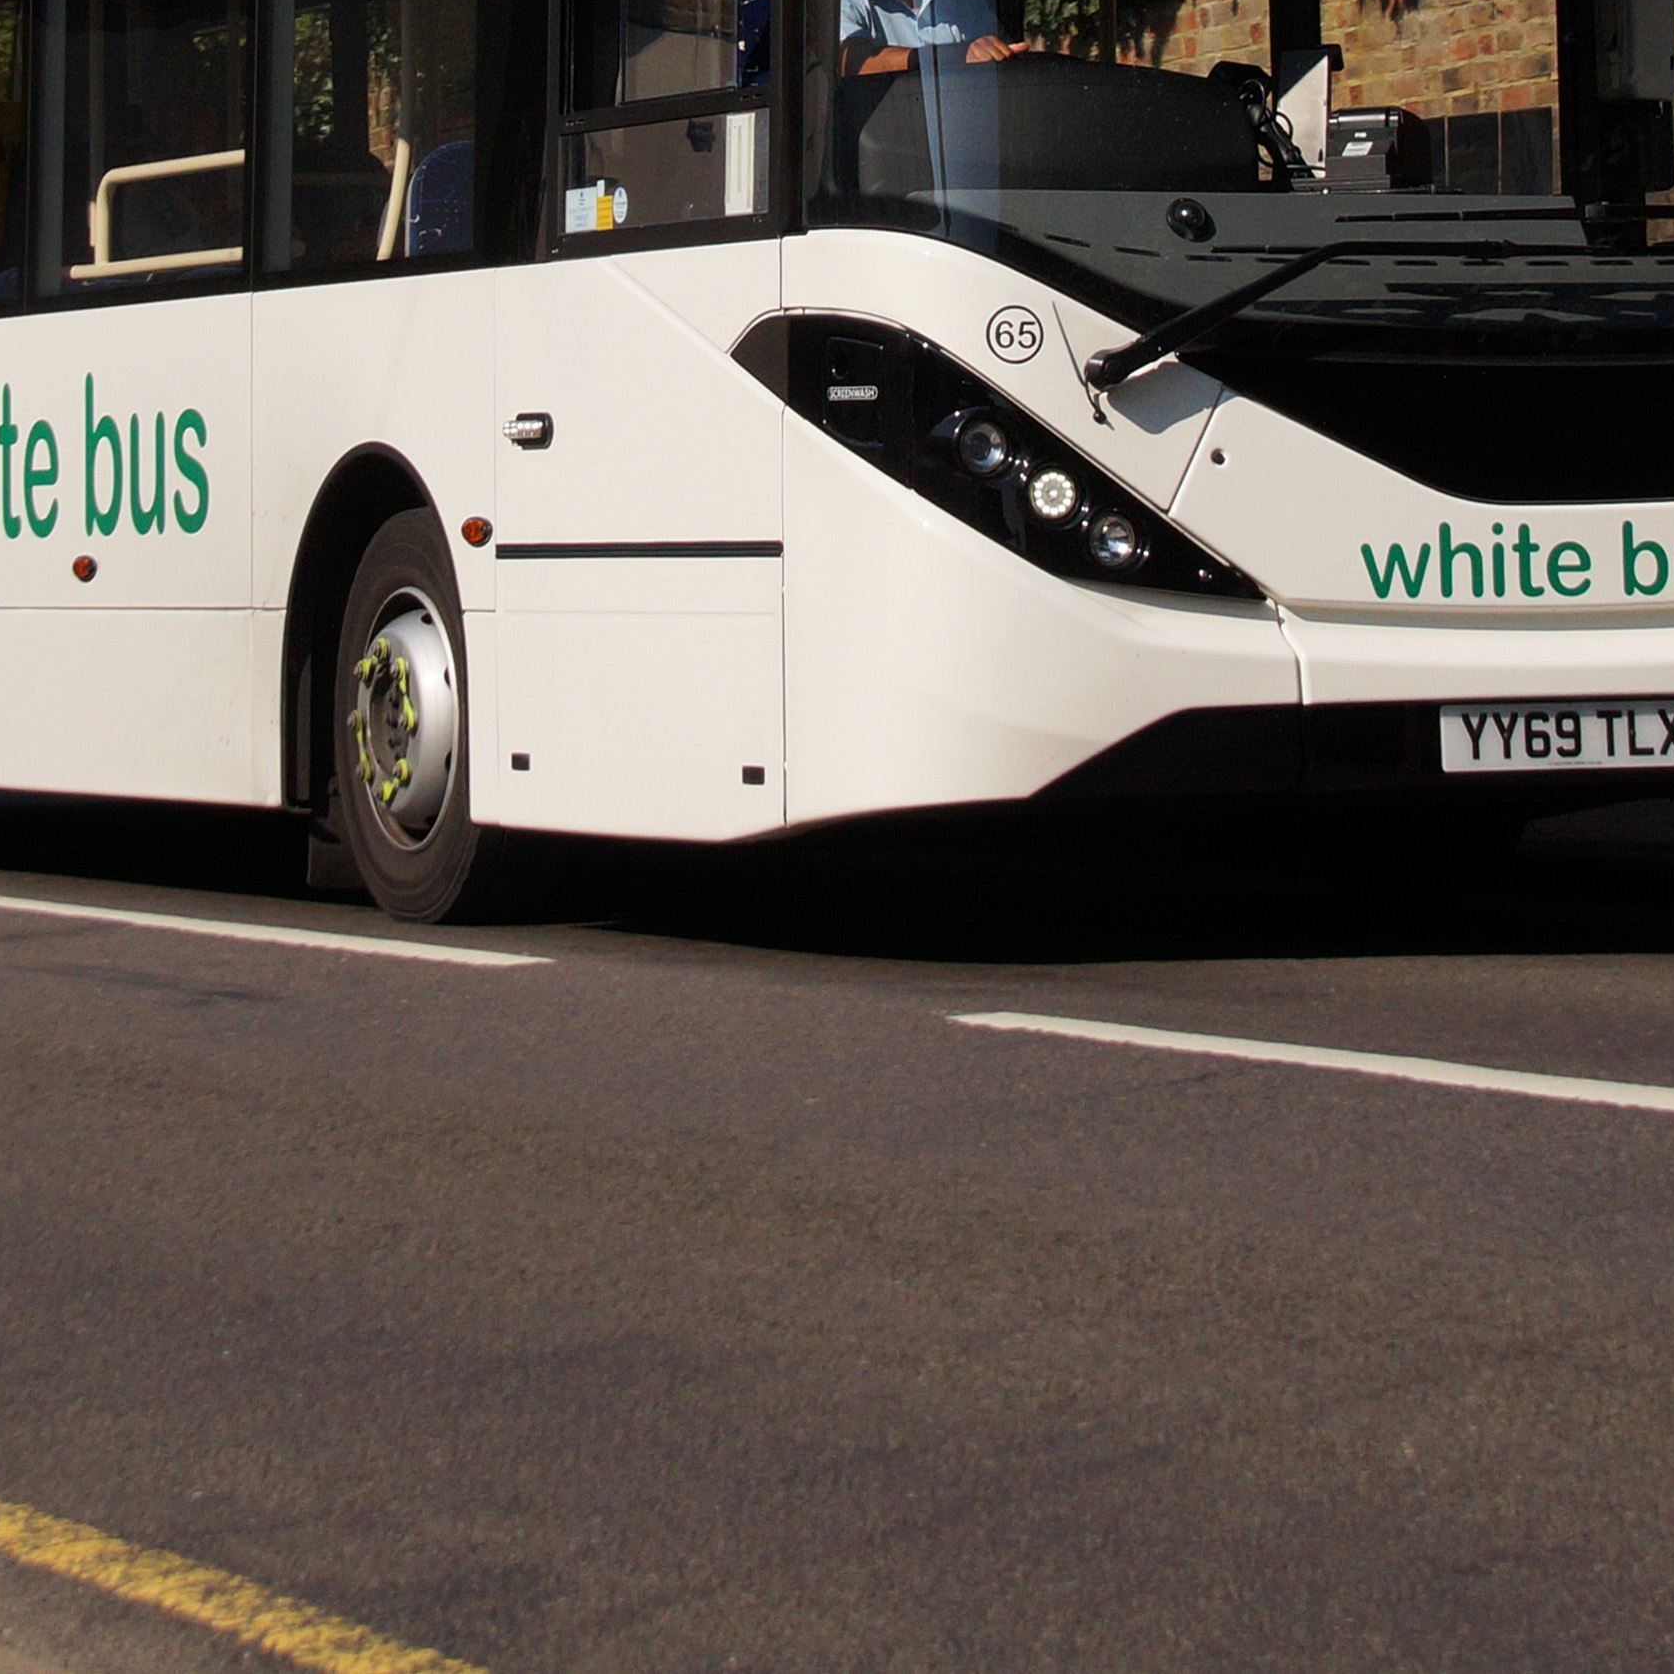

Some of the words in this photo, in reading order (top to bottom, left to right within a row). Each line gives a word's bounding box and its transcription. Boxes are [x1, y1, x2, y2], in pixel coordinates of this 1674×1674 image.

[995, 320, 1037, 349] 65
[84, 372, 210, 537] bus
[1361, 522, 1593, 599] white
[1461, 711, 1582, 760] YY69
